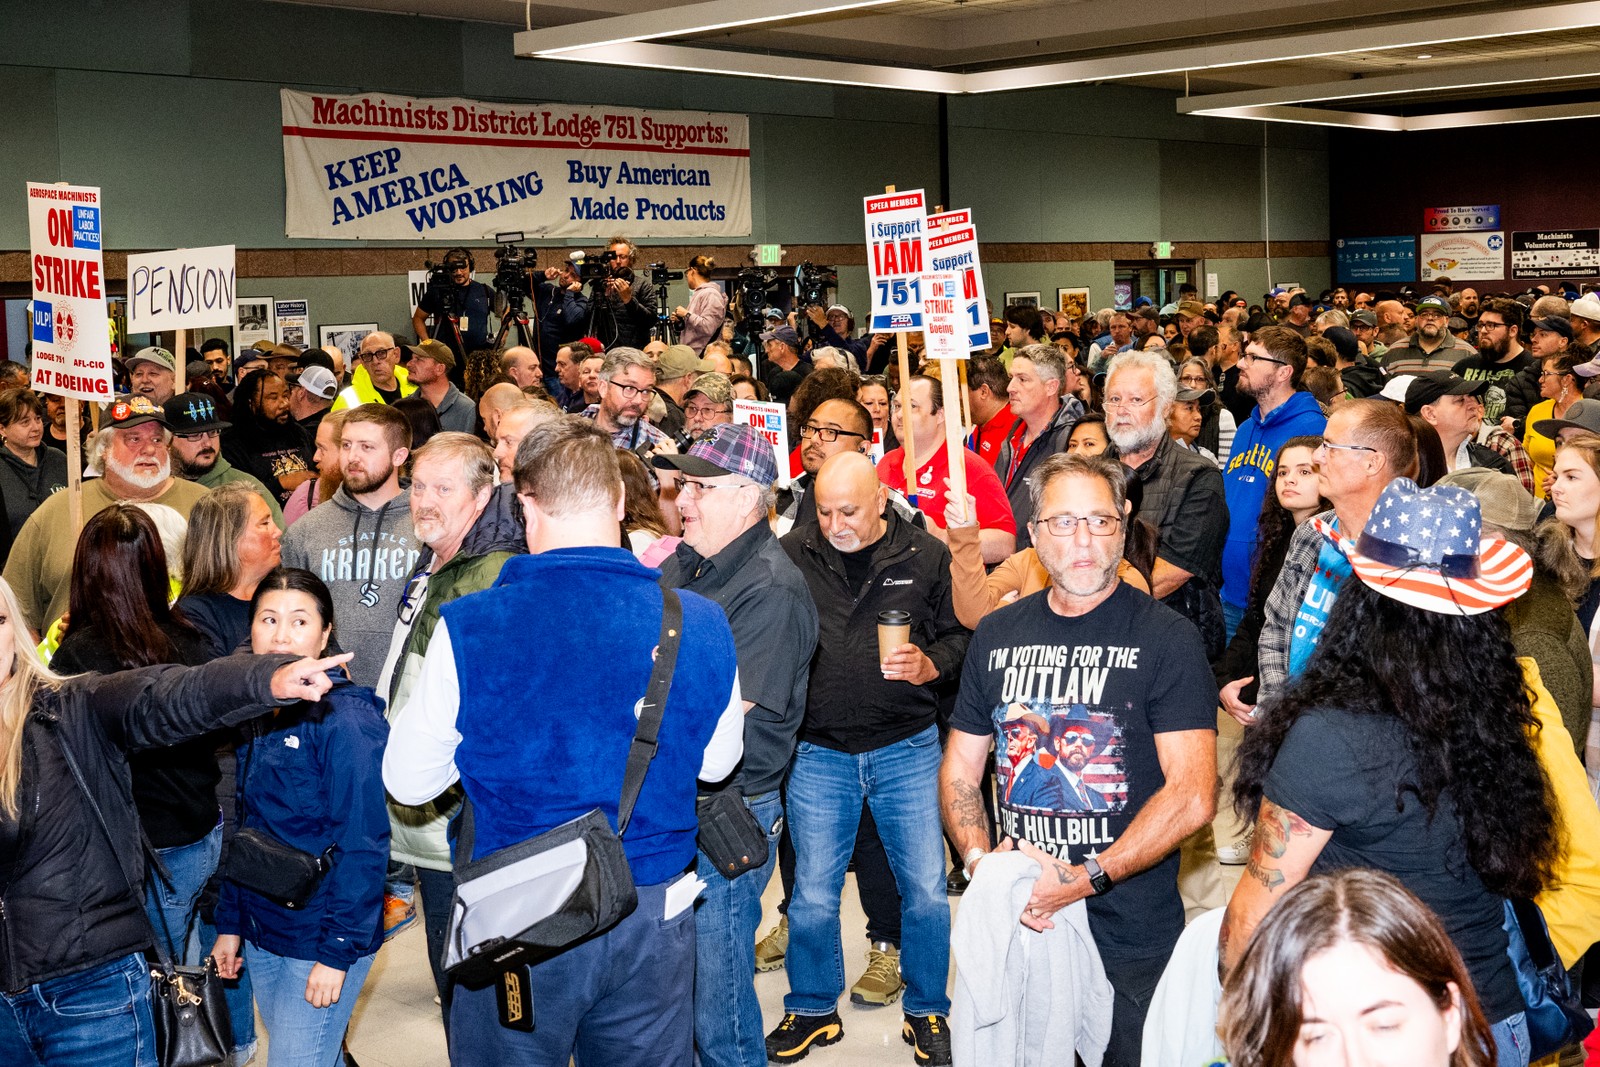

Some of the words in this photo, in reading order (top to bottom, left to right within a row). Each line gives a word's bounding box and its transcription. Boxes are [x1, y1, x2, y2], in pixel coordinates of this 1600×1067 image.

[312, 97, 448, 130] Machinists
[452, 106, 538, 136] District
[541, 111, 600, 145] Lodge
[604, 115, 638, 139] 751
[641, 117, 729, 148] Supports:
[324, 147, 401, 190] KEEP
[567, 159, 612, 188] Buy
[616, 161, 711, 186] American
[30, 188, 57, 200] AEROSPACE
[58, 190, 97, 203] MACHINISTS
[332, 163, 469, 225] AMERICA
[406, 171, 543, 232] WORKING
[870, 200, 889, 211] SPEEA
[889, 197, 918, 208] MEMBER
[77, 208, 95, 220] UNFAIR
[570, 197, 629, 220] Made
[635, 197, 726, 221] Products
[47, 208, 74, 248] ON
[78, 220, 94, 230] LABOR
[871, 222, 875, 238] I
[877, 218, 921, 239] Support
[73, 230, 100, 243] PRACTICES!
[929, 238, 943, 247] PEEA
[943, 232, 970, 244] MEMBER
[1557, 241, 1588, 249] Program
[762, 245, 779, 264] EXIT
[873, 237, 923, 277] IAM
[932, 251, 973, 271] Support
[34, 254, 101, 299] STRIKE
[1560, 268, 1597, 276] Communities
[132, 263, 234, 320] PENSION
[876, 277, 920, 306] 751
[932, 282, 944, 297] ON
[924, 299, 954, 314] STRIKE
[35, 309, 52, 328] ULP!
[929, 322, 954, 335] Boeing
[36, 351, 55, 362] LODGE
[55, 354, 65, 364] 751
[73, 358, 105, 369] AFL-CIO
[35, 368, 52, 385] AT
[55, 372, 109, 394] BOEING
[735, 403, 764, 412] MACHINISTS
[750, 413, 765, 428] ON
[1227, 443, 1275, 478] seattle
[338, 531, 408, 546] SEATTLE
[988, 648, 1010, 671] I'M
[1010, 644, 1067, 668] VOTING
[1070, 645, 1102, 667] FOR
[1106, 646, 1140, 669] THE
[1001, 666, 1110, 704] OUTLAW
[1001, 808, 1020, 839] THE
